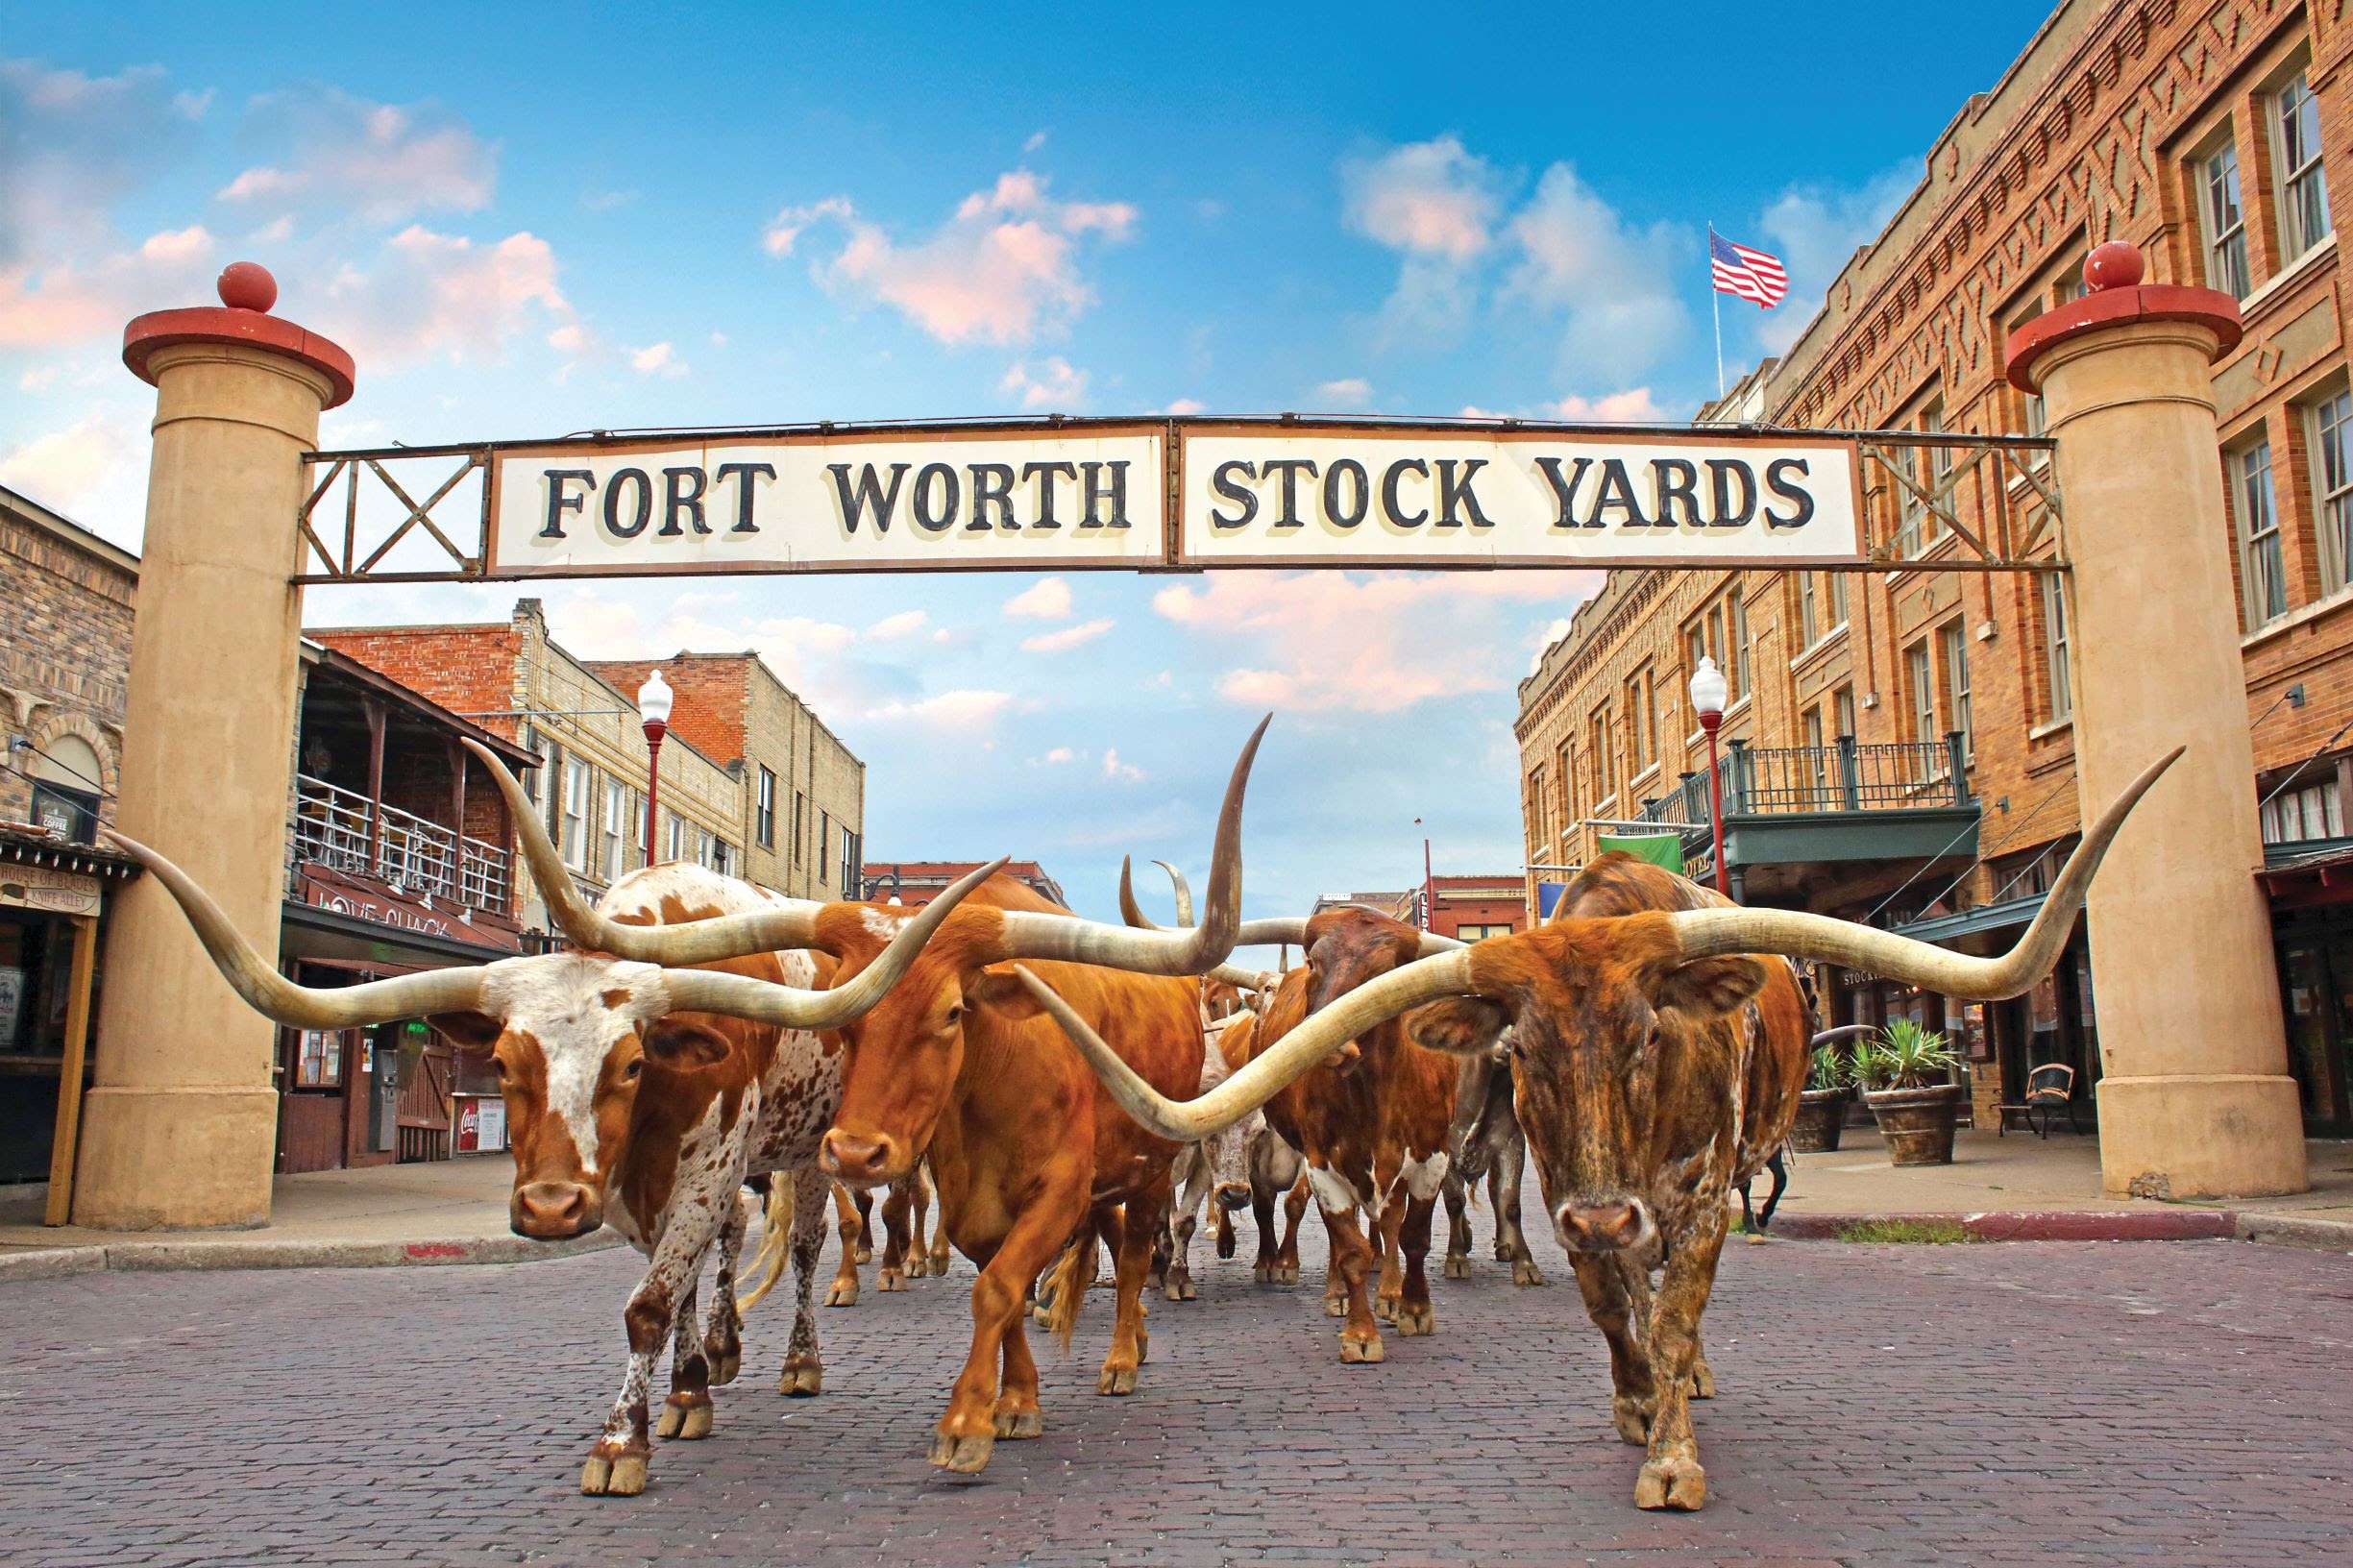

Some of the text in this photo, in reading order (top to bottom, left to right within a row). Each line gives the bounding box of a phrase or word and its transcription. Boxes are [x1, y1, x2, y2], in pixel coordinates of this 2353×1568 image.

[539, 456, 1815, 538] FORT WORTH STOCK YARDS
[1683, 854, 1710, 878] OTEL
[1, 866, 96, 892] HOUSE OF BLADES
[32, 891, 86, 908] KNIFE ALLEY
[1844, 970, 1877, 986] STOCK
